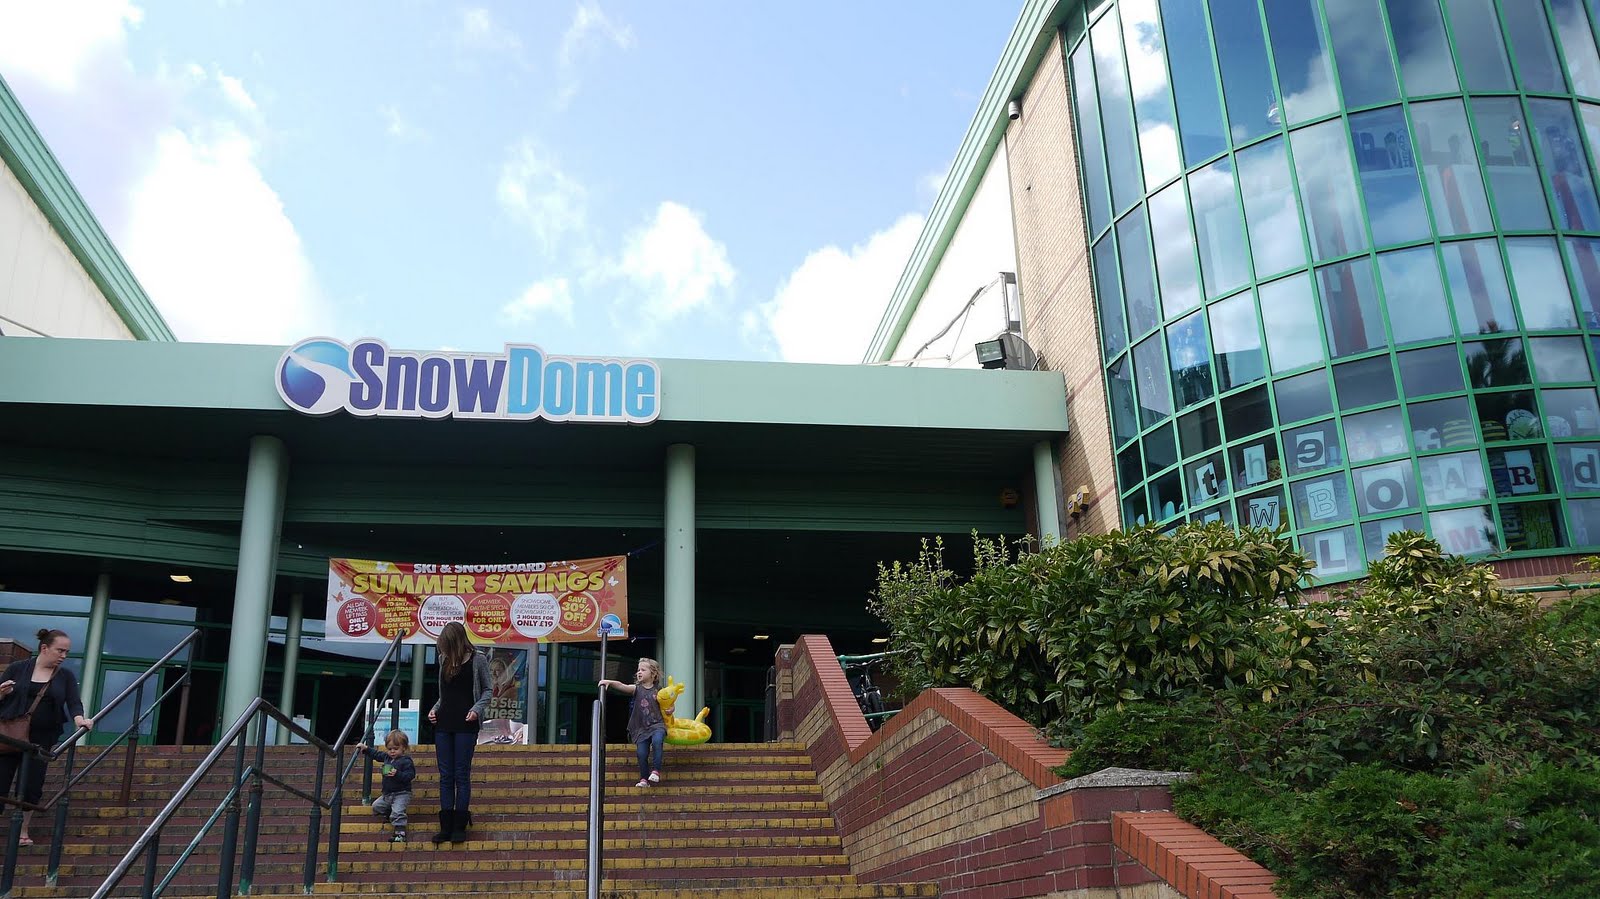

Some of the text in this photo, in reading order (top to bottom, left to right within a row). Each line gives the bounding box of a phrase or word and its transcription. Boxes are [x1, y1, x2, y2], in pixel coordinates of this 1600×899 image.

[349, 343, 655, 417] SnowDome
[414, 562, 546, 574] SKI & SNOWBOARD
[352, 571, 605, 595] SUMMER SAVINGS
[568, 595, 587, 603] SAVE
[561, 601, 591, 614] 30%
[563, 611, 587, 622] OFF
[348, 622, 369, 633] £35
[477, 623, 502, 633] £30
[491, 697, 525, 708] 5 Star
